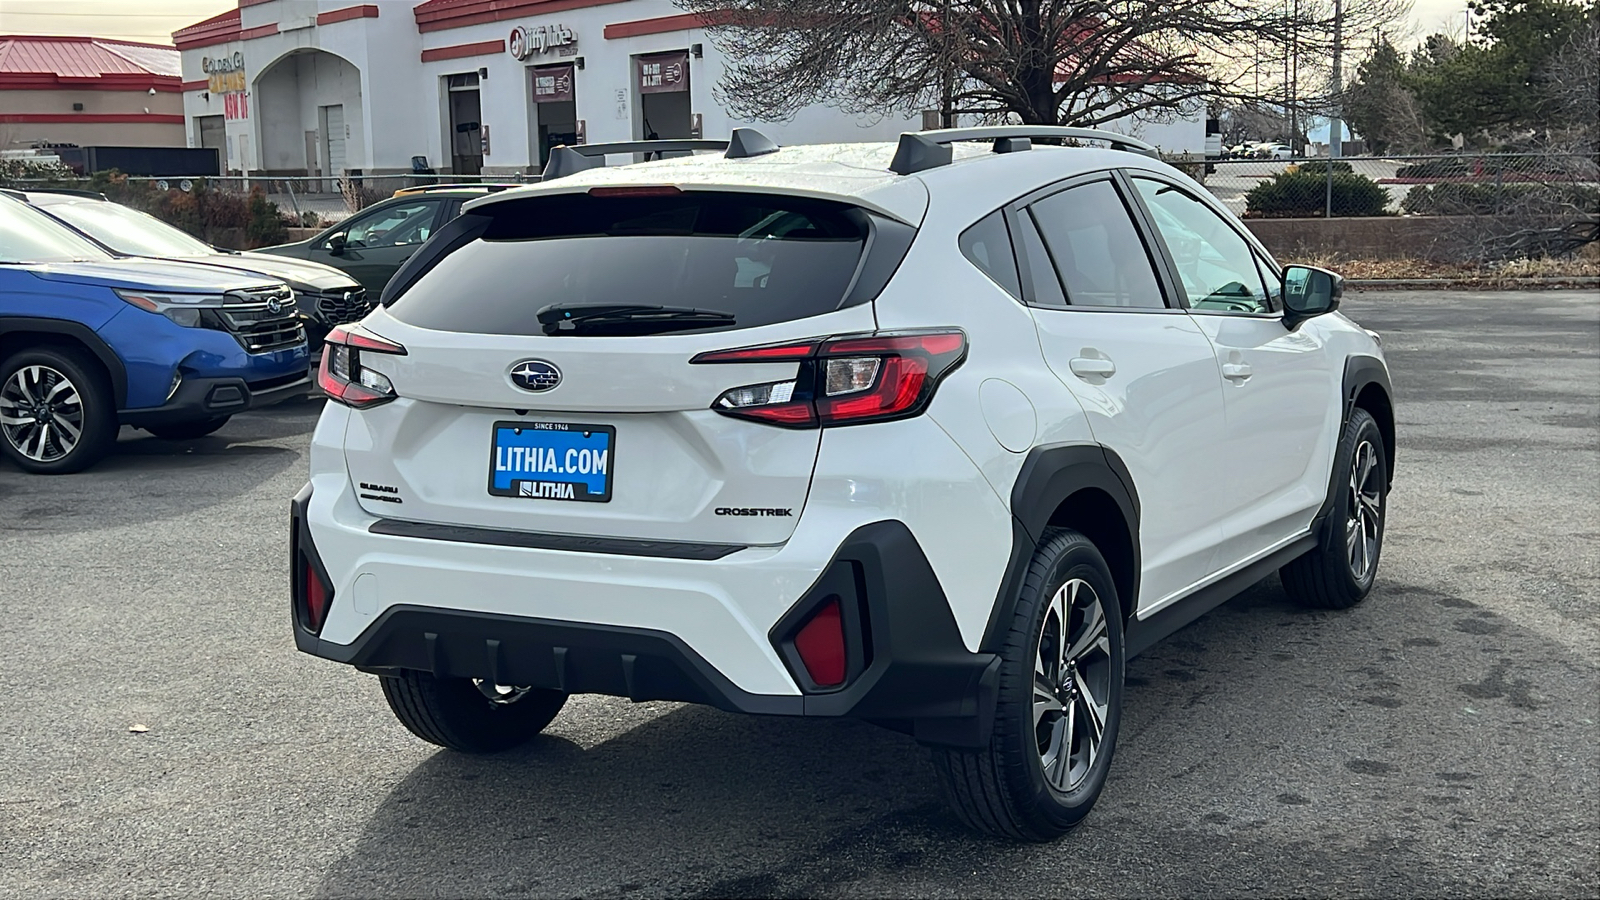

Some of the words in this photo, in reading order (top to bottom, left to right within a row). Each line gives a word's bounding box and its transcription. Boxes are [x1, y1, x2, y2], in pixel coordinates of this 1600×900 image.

[202, 56, 232, 73] GOLDEN
[534, 422, 553, 430] SINCE
[553, 423, 569, 431] 1946
[495, 446, 608, 475] LITHIA.COM
[360, 482, 398, 494] SUBARU
[532, 482, 575, 499] LITHIA
[714, 507, 793, 517] CROSSTREK
